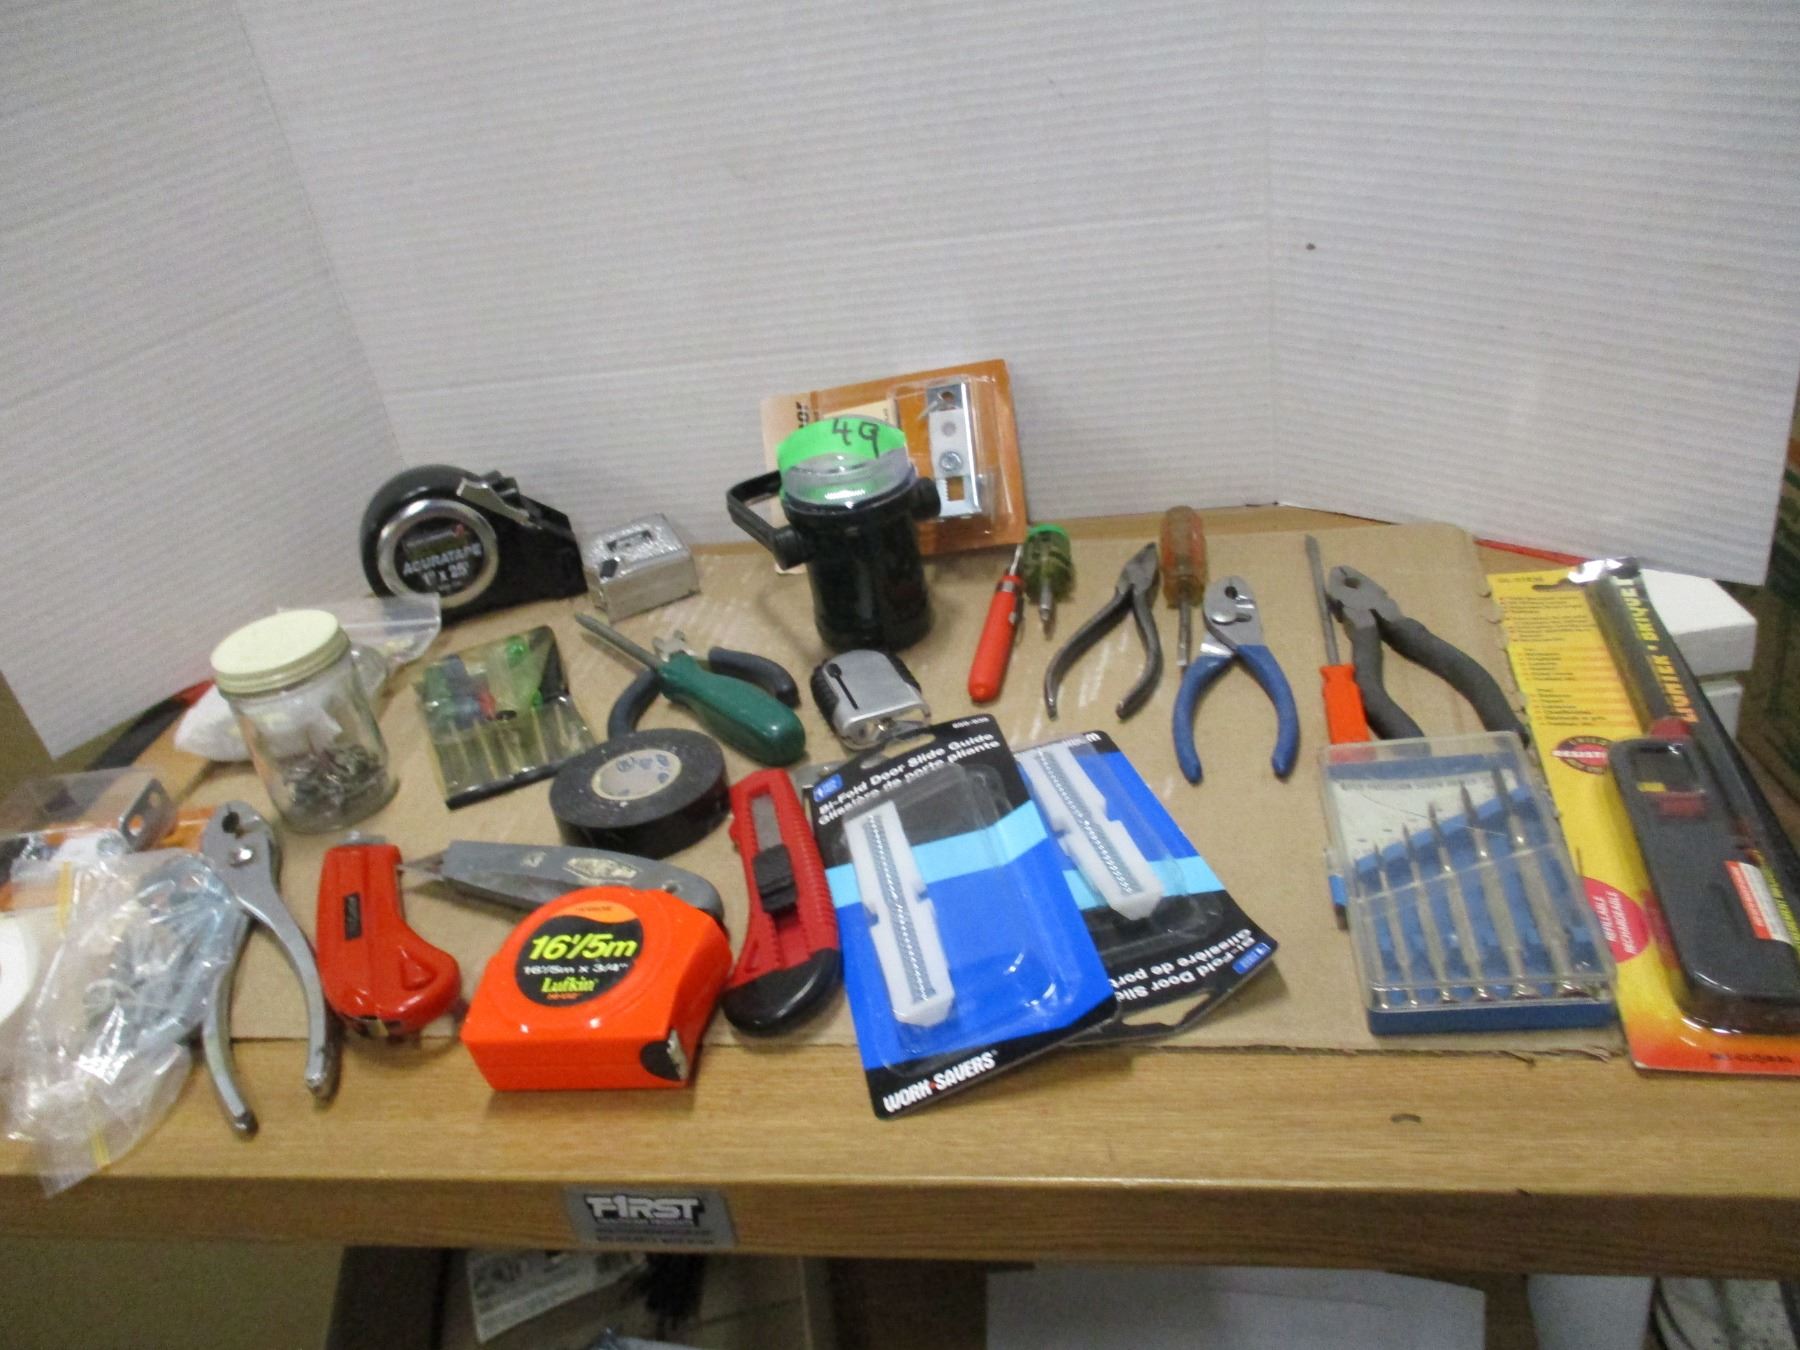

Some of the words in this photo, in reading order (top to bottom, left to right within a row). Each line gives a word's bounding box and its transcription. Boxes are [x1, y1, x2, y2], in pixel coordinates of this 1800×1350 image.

[832, 418, 881, 459] 49
[819, 780, 868, 816] Bi-Fold
[869, 764, 905, 786] Door
[907, 747, 946, 768] Slide
[948, 732, 995, 752] Guide
[905, 759, 945, 784] porte
[947, 740, 1001, 764] pliante
[529, 933, 637, 960] 16'/5m
[578, 965, 589, 973] x
[1109, 968, 1148, 989] port
[1150, 962, 1175, 976] de
[541, 976, 596, 993] Lufkin
[1151, 973, 1196, 990] Door
[883, 1079, 933, 1113] WORK
[934, 1052, 996, 1091] SAVERS
